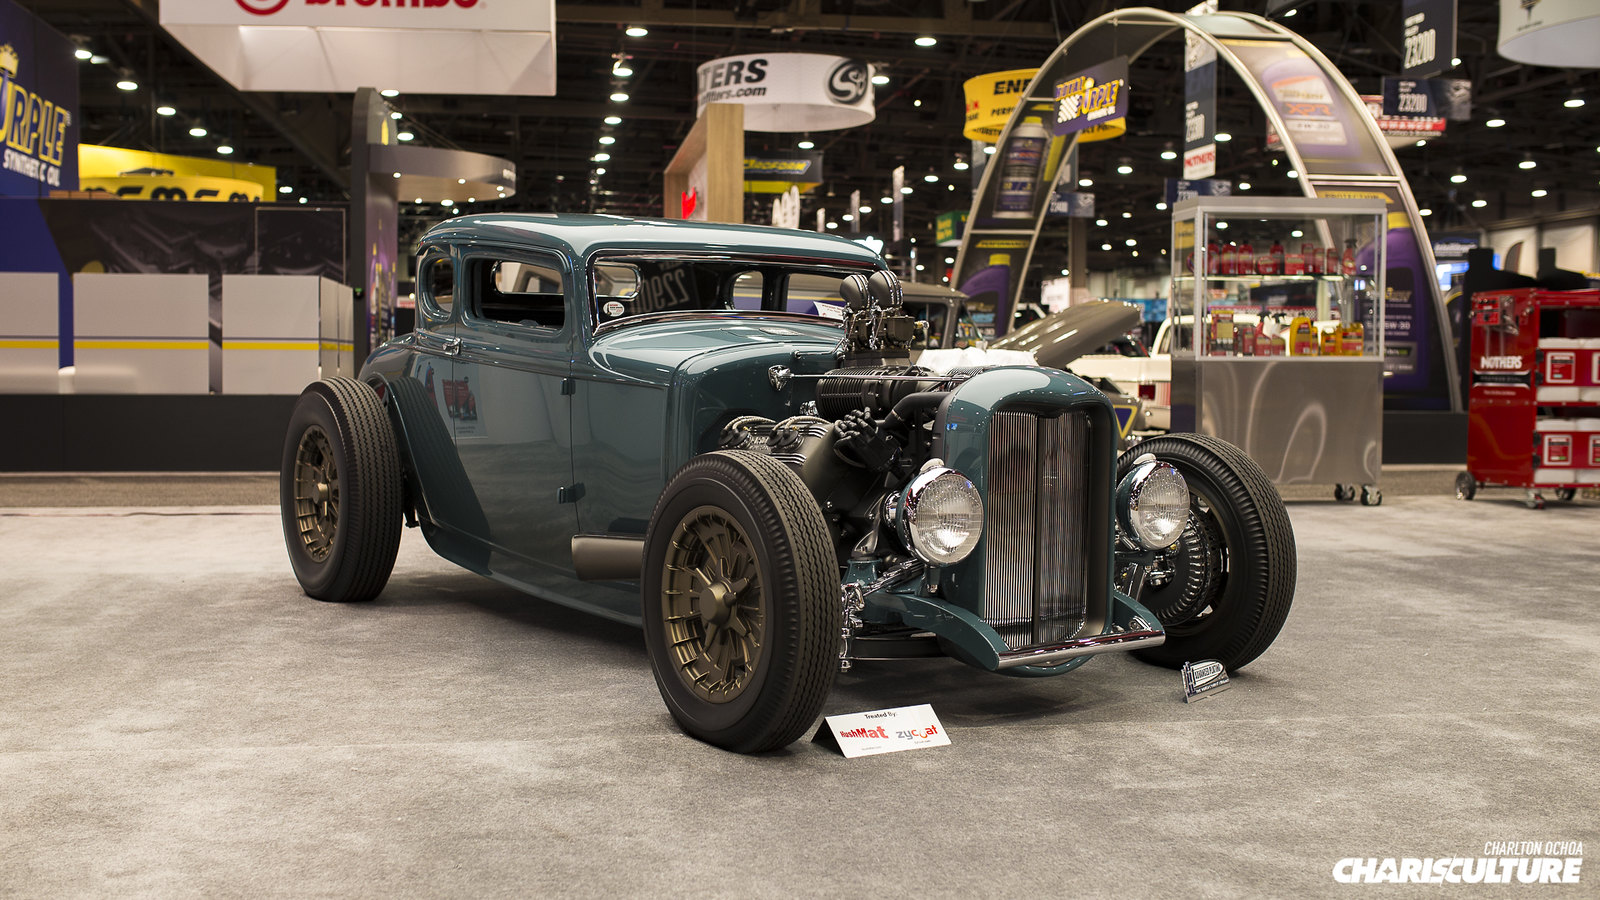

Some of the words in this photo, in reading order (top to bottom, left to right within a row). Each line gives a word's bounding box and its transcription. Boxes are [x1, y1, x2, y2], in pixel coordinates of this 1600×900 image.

[1404, 28, 1436, 69] 23200
[1398, 93, 1428, 113] 23200
[1379, 120, 1434, 132] RMANCE
[3, 149, 47, 182] SYNTHETC
[1481, 356, 1522, 369] MOTHERS
[864, 711, 887, 720] Treated
[840, 725, 888, 739] HushMat
